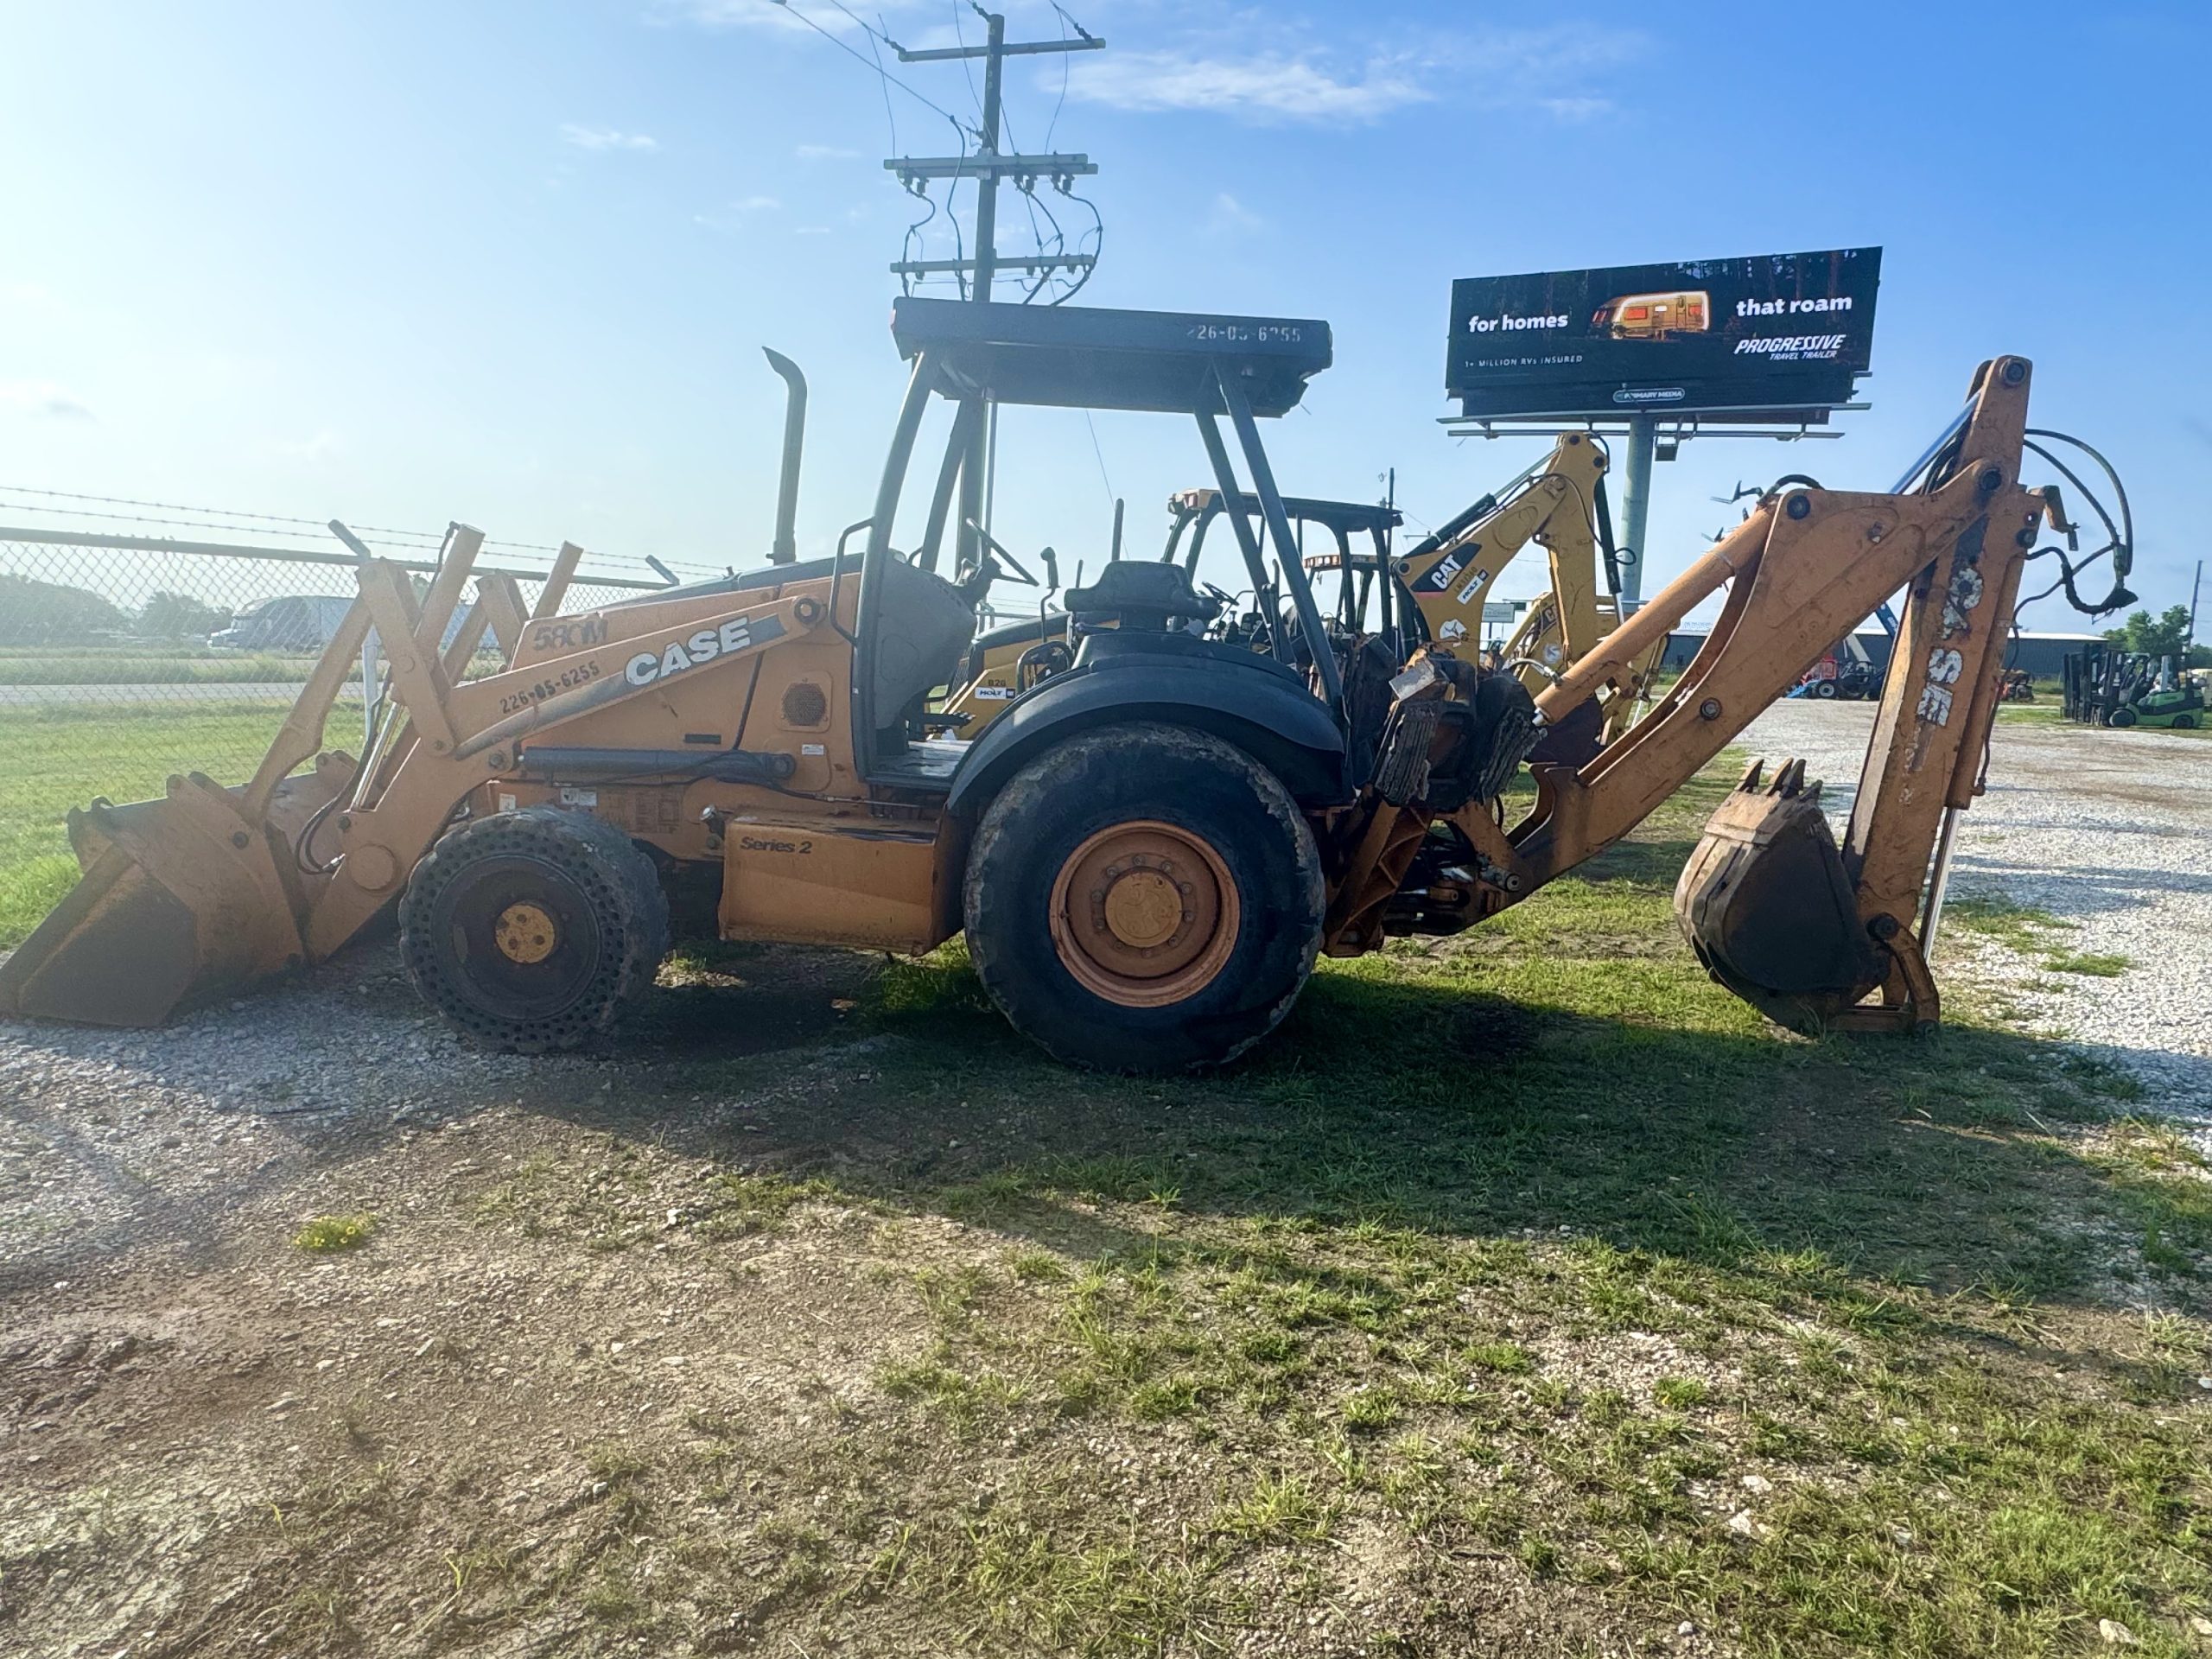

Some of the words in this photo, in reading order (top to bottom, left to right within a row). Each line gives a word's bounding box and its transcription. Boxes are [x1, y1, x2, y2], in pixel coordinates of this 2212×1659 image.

[1736, 298, 1786, 316] that
[1789, 296, 1853, 314] roam
[1468, 315, 1499, 333] for
[1502, 314, 1569, 331] homes
[1733, 334, 1847, 354] PROGRESSIVE
[1478, 359, 1517, 367] MILLION
[1521, 357, 1537, 365] RVs
[1541, 355, 1584, 365] INSURED
[1770, 352, 1800, 360] TRAVEL
[1802, 350, 1838, 359] TRAILER
[1431, 554, 1464, 589] CAT
[623, 617, 751, 687] CASE
[1916, 566, 1984, 726] CASE
[499, 660, 601, 714] 226-05-6255
[740, 836, 796, 854] Series
[798, 841, 813, 855] 2
